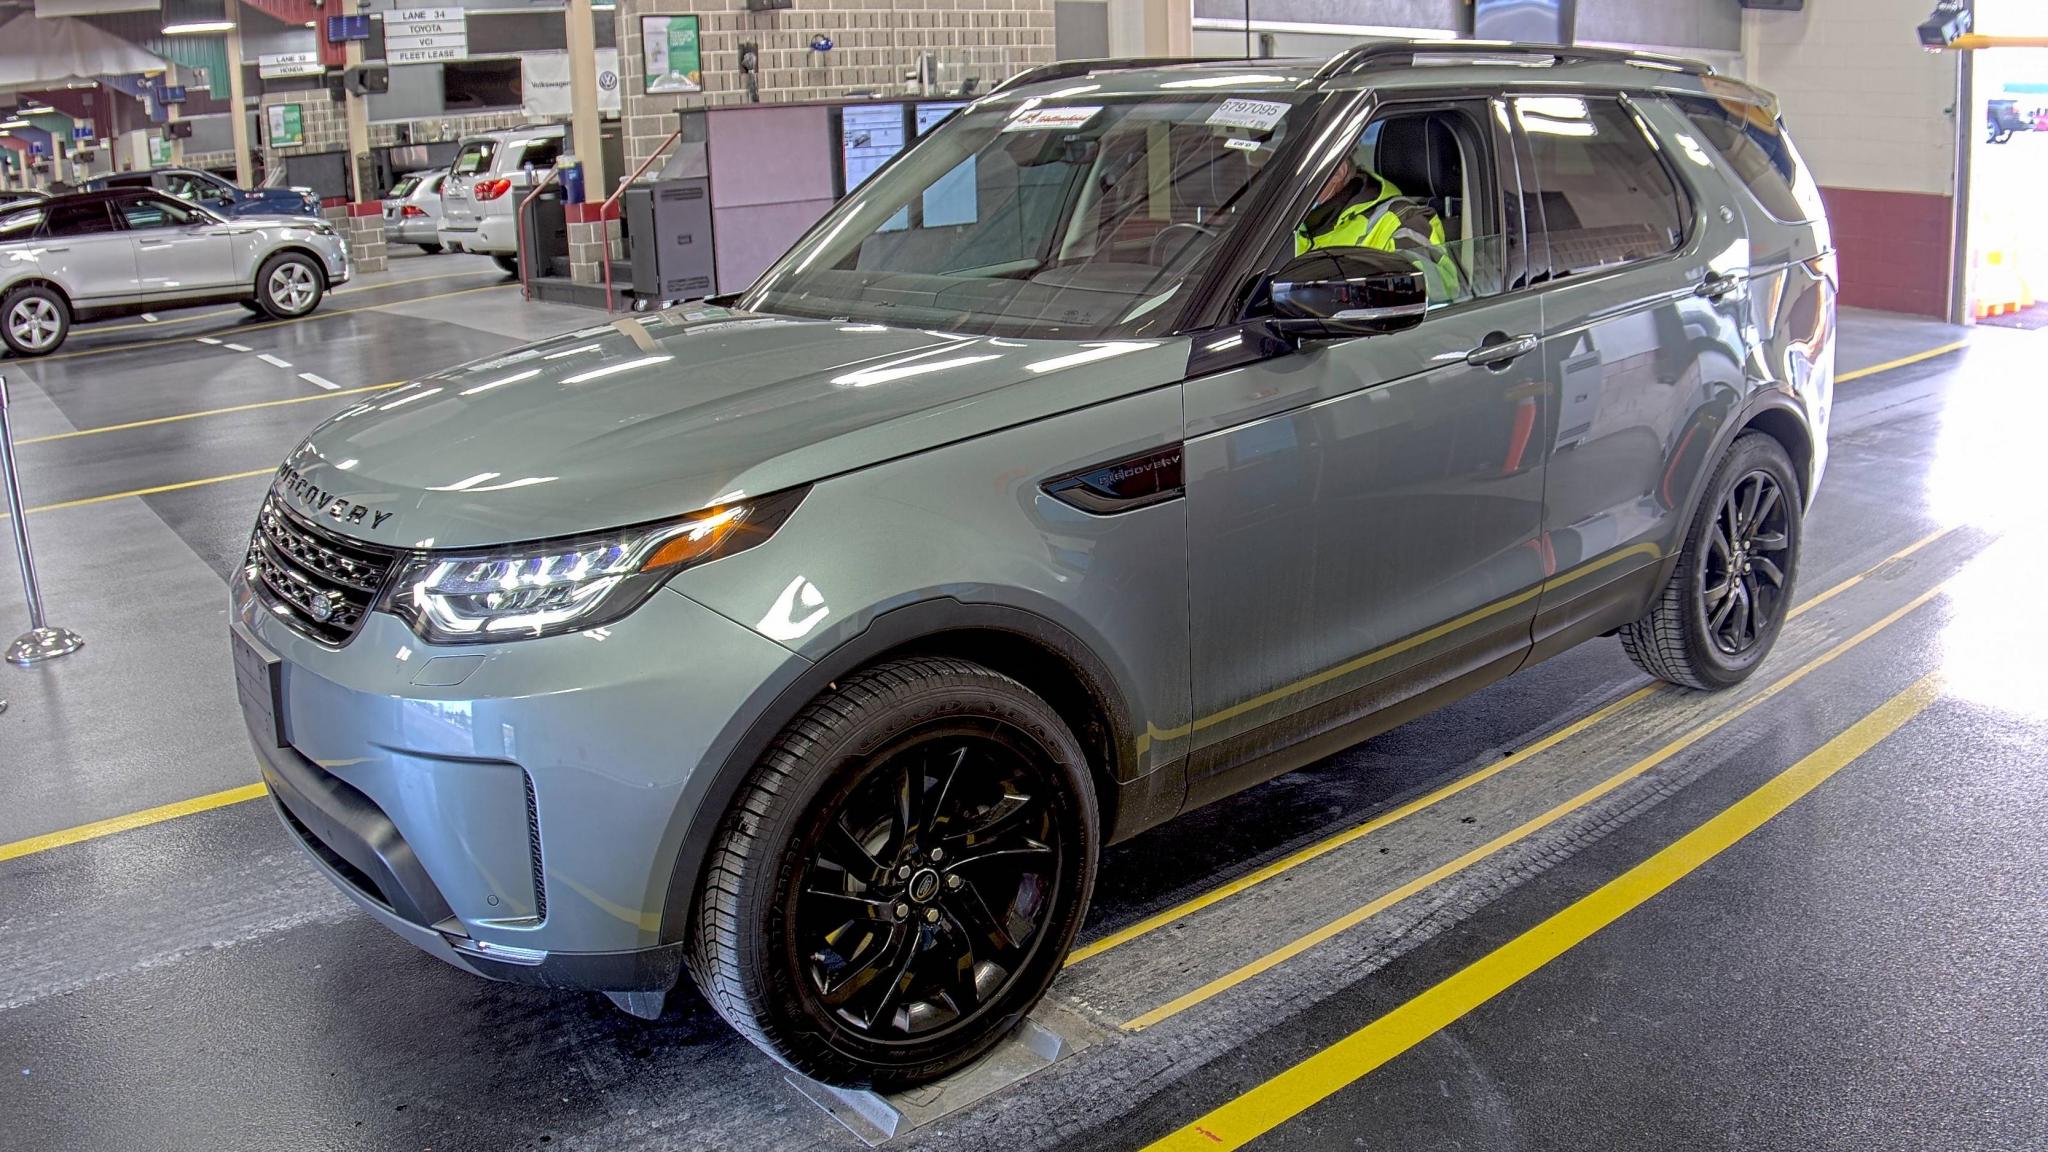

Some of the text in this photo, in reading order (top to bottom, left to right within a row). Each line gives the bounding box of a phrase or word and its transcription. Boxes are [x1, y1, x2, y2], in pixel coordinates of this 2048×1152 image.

[402, 10, 445, 20] LANE 34
[409, 24, 442, 33] TOYOTA
[419, 38, 433, 46] VCI
[275, 55, 295, 63] LANE
[400, 49, 454, 60] FLEET LEASE
[1220, 101, 1280, 116] 6797095
